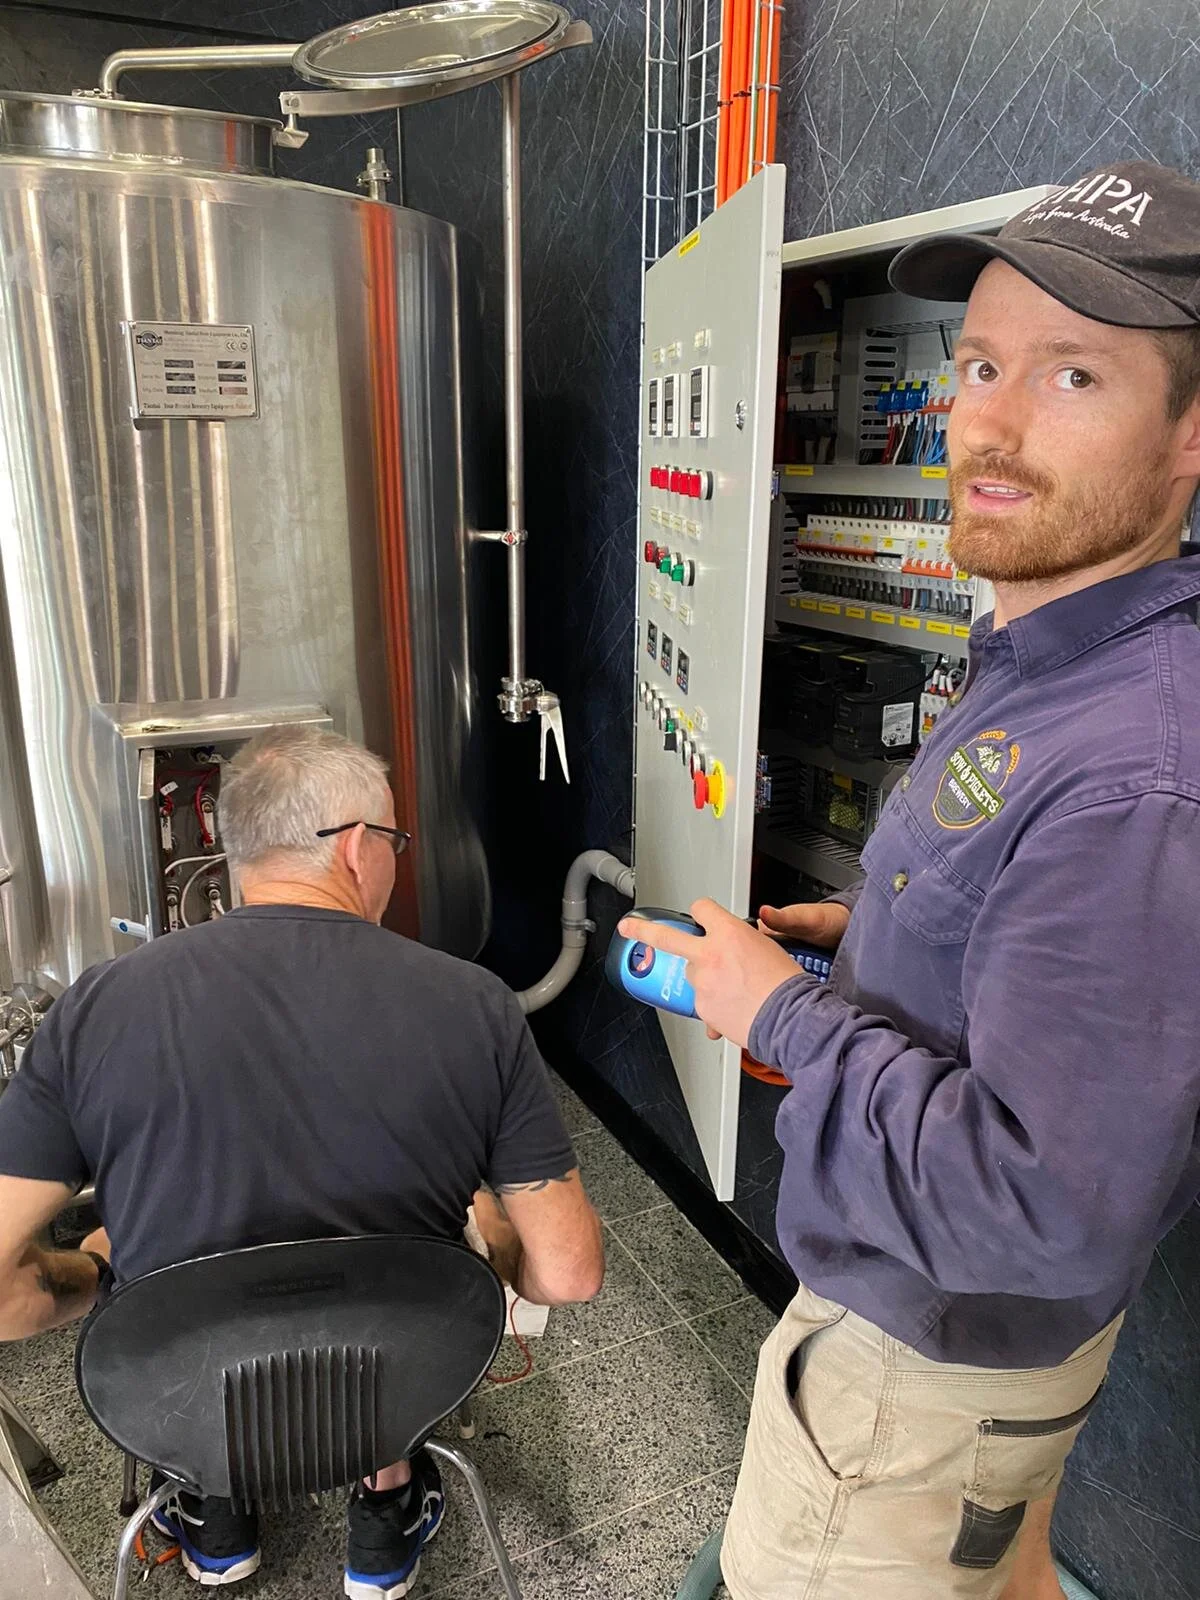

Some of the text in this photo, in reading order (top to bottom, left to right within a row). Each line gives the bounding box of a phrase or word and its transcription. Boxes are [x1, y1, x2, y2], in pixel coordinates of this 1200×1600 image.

[1072, 208, 1131, 239] Australia
[948, 778, 972, 809] BREWERY
[950, 751, 999, 813] SOW & PIGLETS
